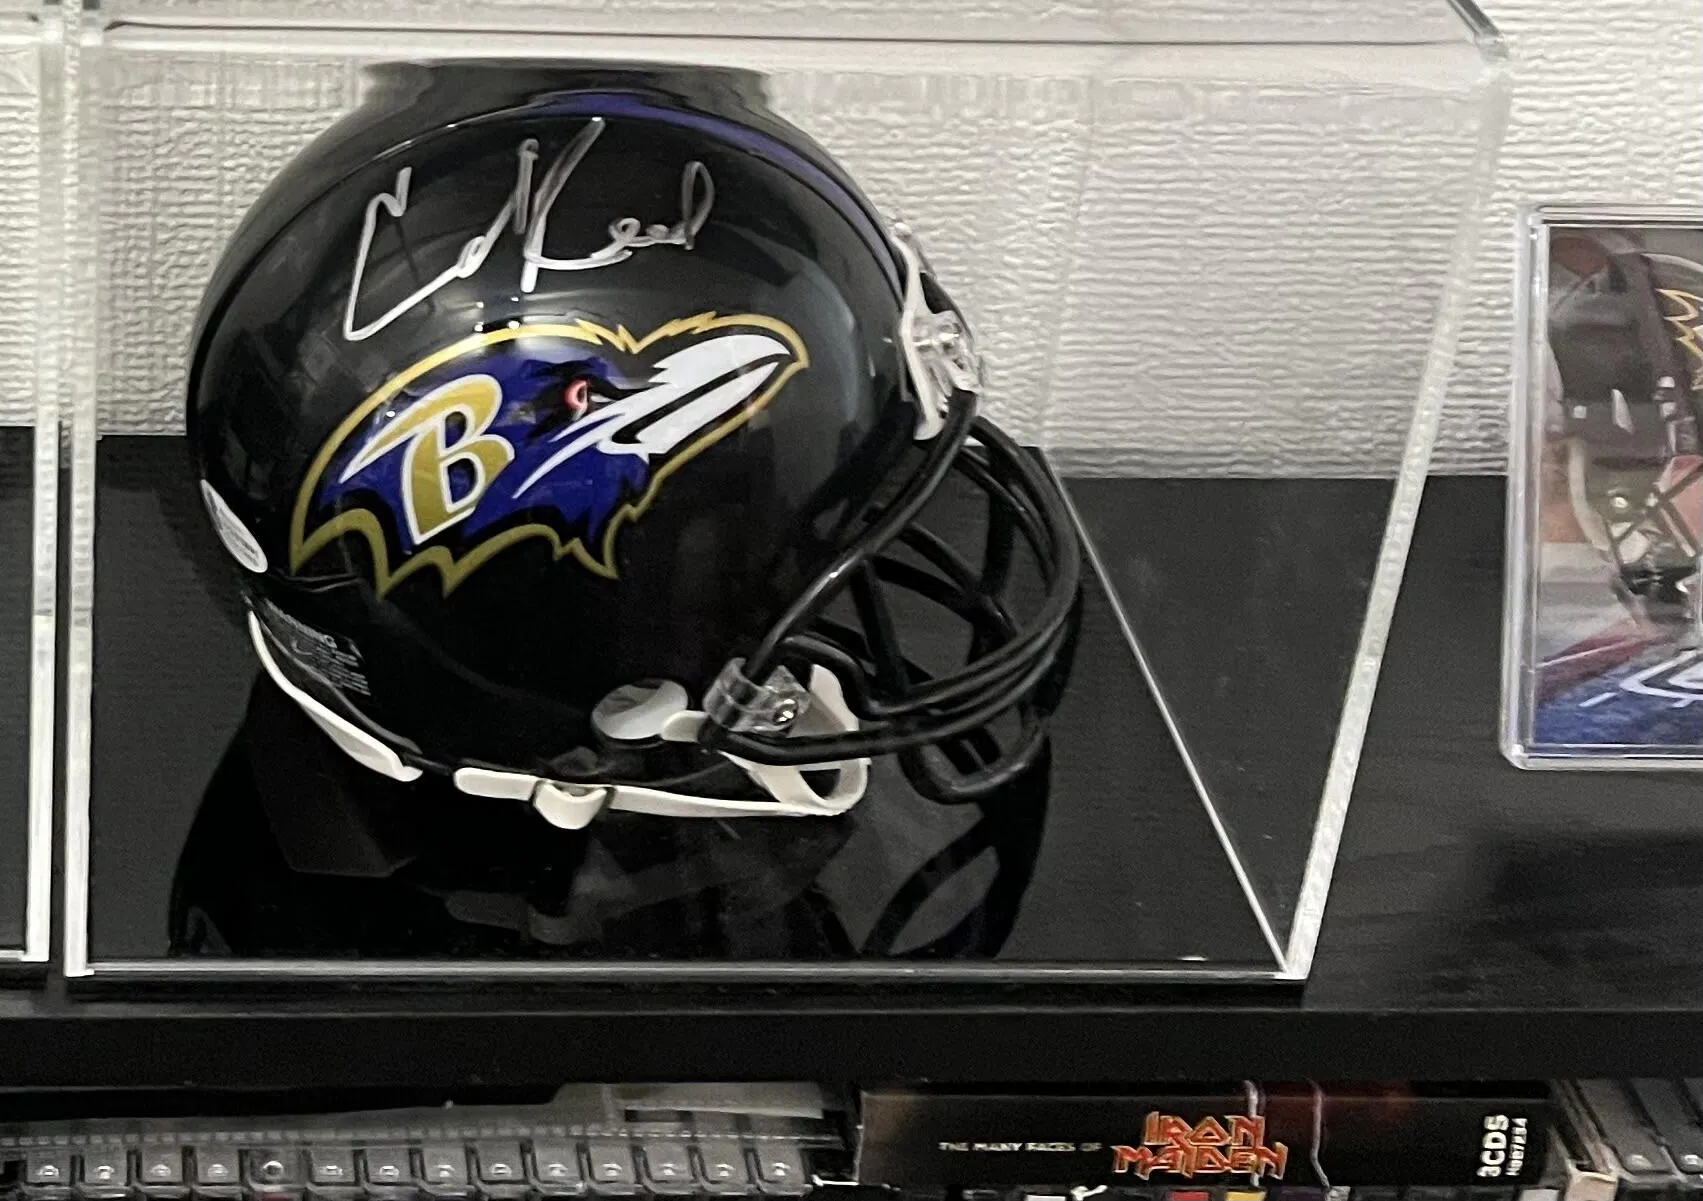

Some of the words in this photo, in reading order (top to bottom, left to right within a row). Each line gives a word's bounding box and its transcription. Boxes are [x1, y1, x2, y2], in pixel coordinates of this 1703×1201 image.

[938, 1142, 969, 1151] THE
[972, 1142, 1024, 1151] MANY
[1025, 1142, 1076, 1151] FACES
[1143, 1111, 1266, 1150] IRON
[1110, 1142, 1289, 1181] MAIDEN
